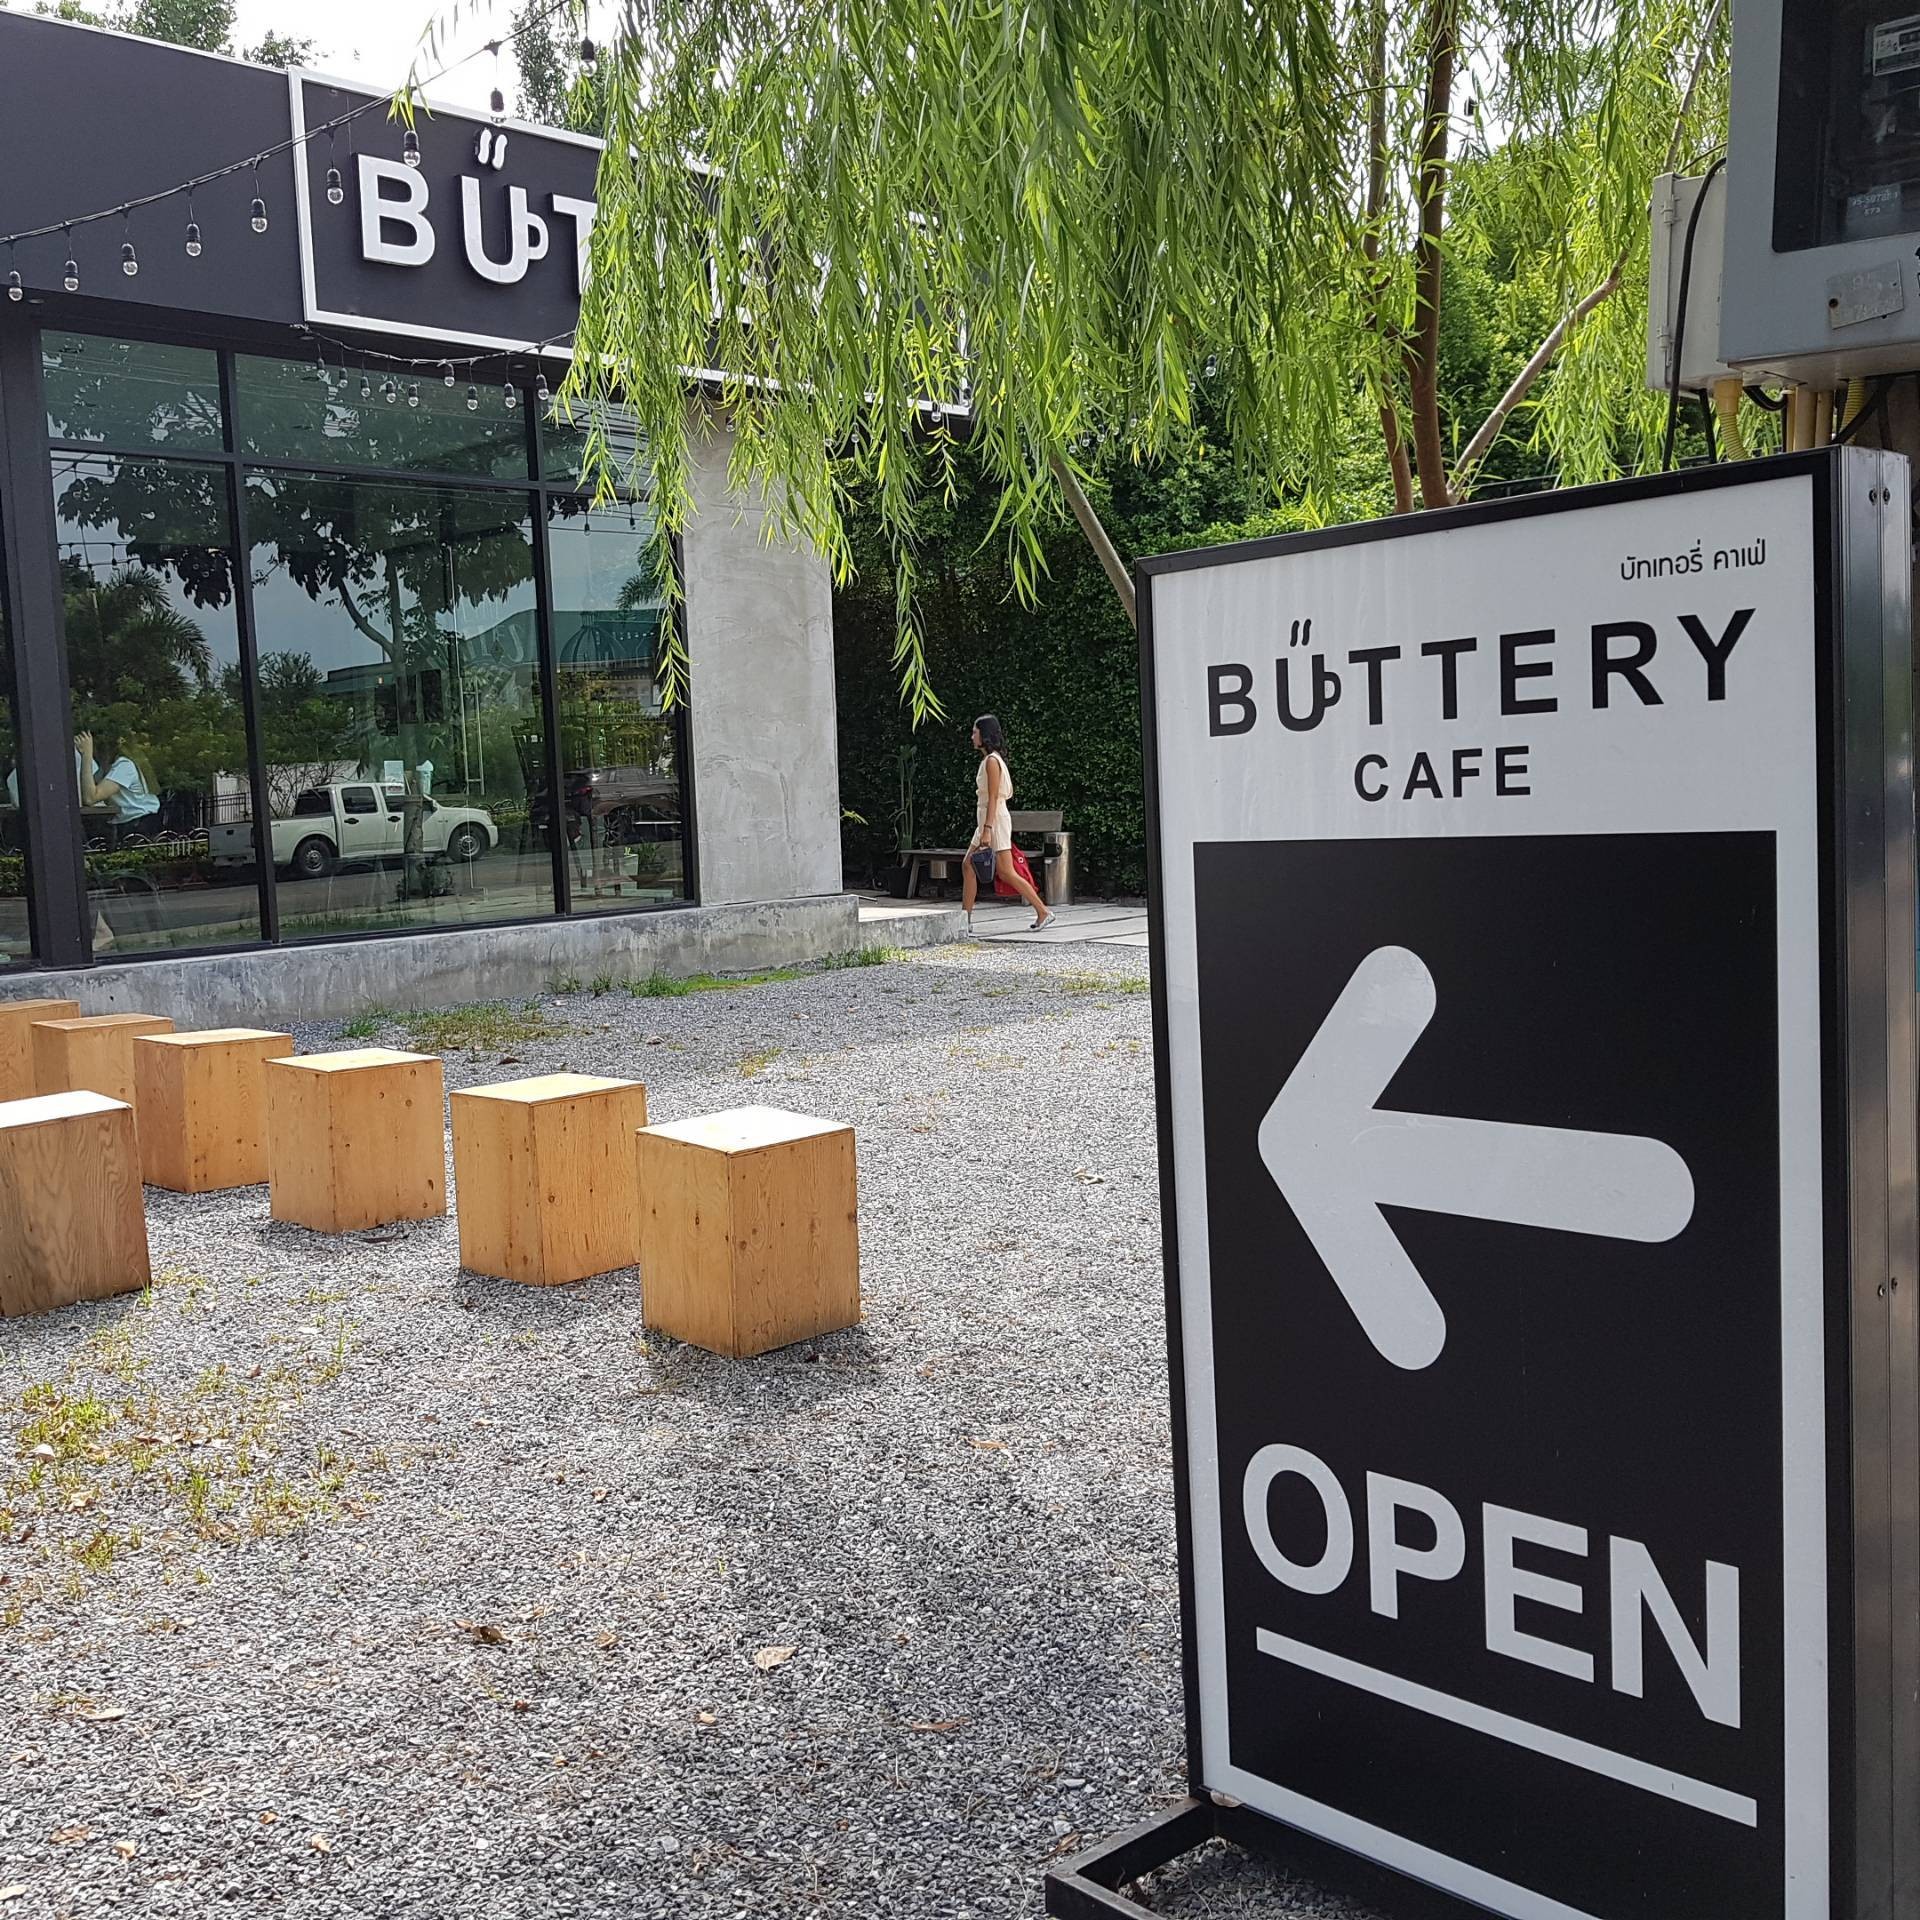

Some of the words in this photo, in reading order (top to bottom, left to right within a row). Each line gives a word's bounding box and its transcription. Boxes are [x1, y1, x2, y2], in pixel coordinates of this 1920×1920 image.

[1713, 537, 1766, 571] คาเฟ่
[1207, 608, 1756, 738] BUTTERY
[1354, 745, 1532, 802] CAFE
[1242, 1442, 1741, 1729] OPEN
